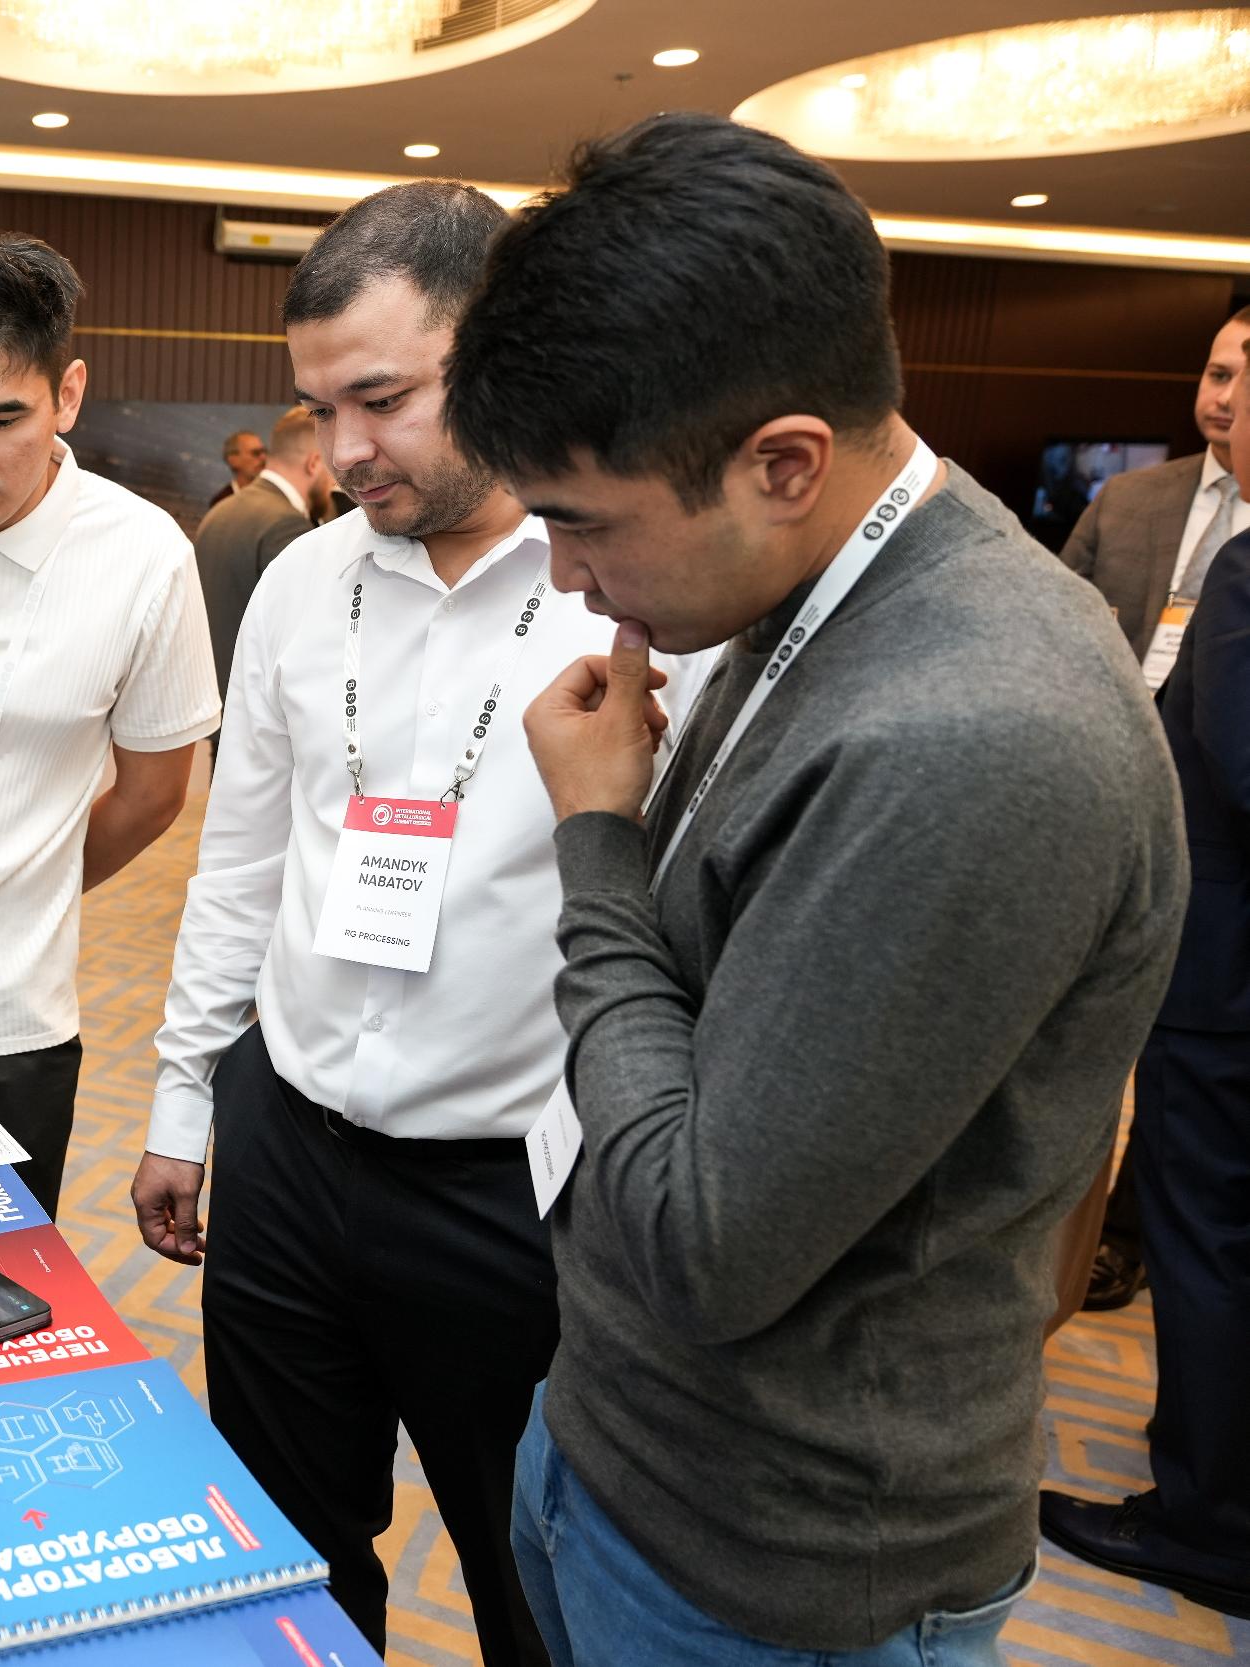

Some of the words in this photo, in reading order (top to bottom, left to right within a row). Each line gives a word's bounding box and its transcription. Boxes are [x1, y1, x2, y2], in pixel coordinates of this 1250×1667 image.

[863, 487, 910, 541] BSG
[350, 583, 363, 620] BSG
[514, 597, 541, 637] BSG
[345, 679, 357, 718] BSG
[473, 699, 497, 739] BSG
[358, 873, 423, 892] NABATOV
[361, 855, 428, 874] AMANDYK
[344, 929, 357, 938] RG
[358, 931, 411, 947] PROCESSING
